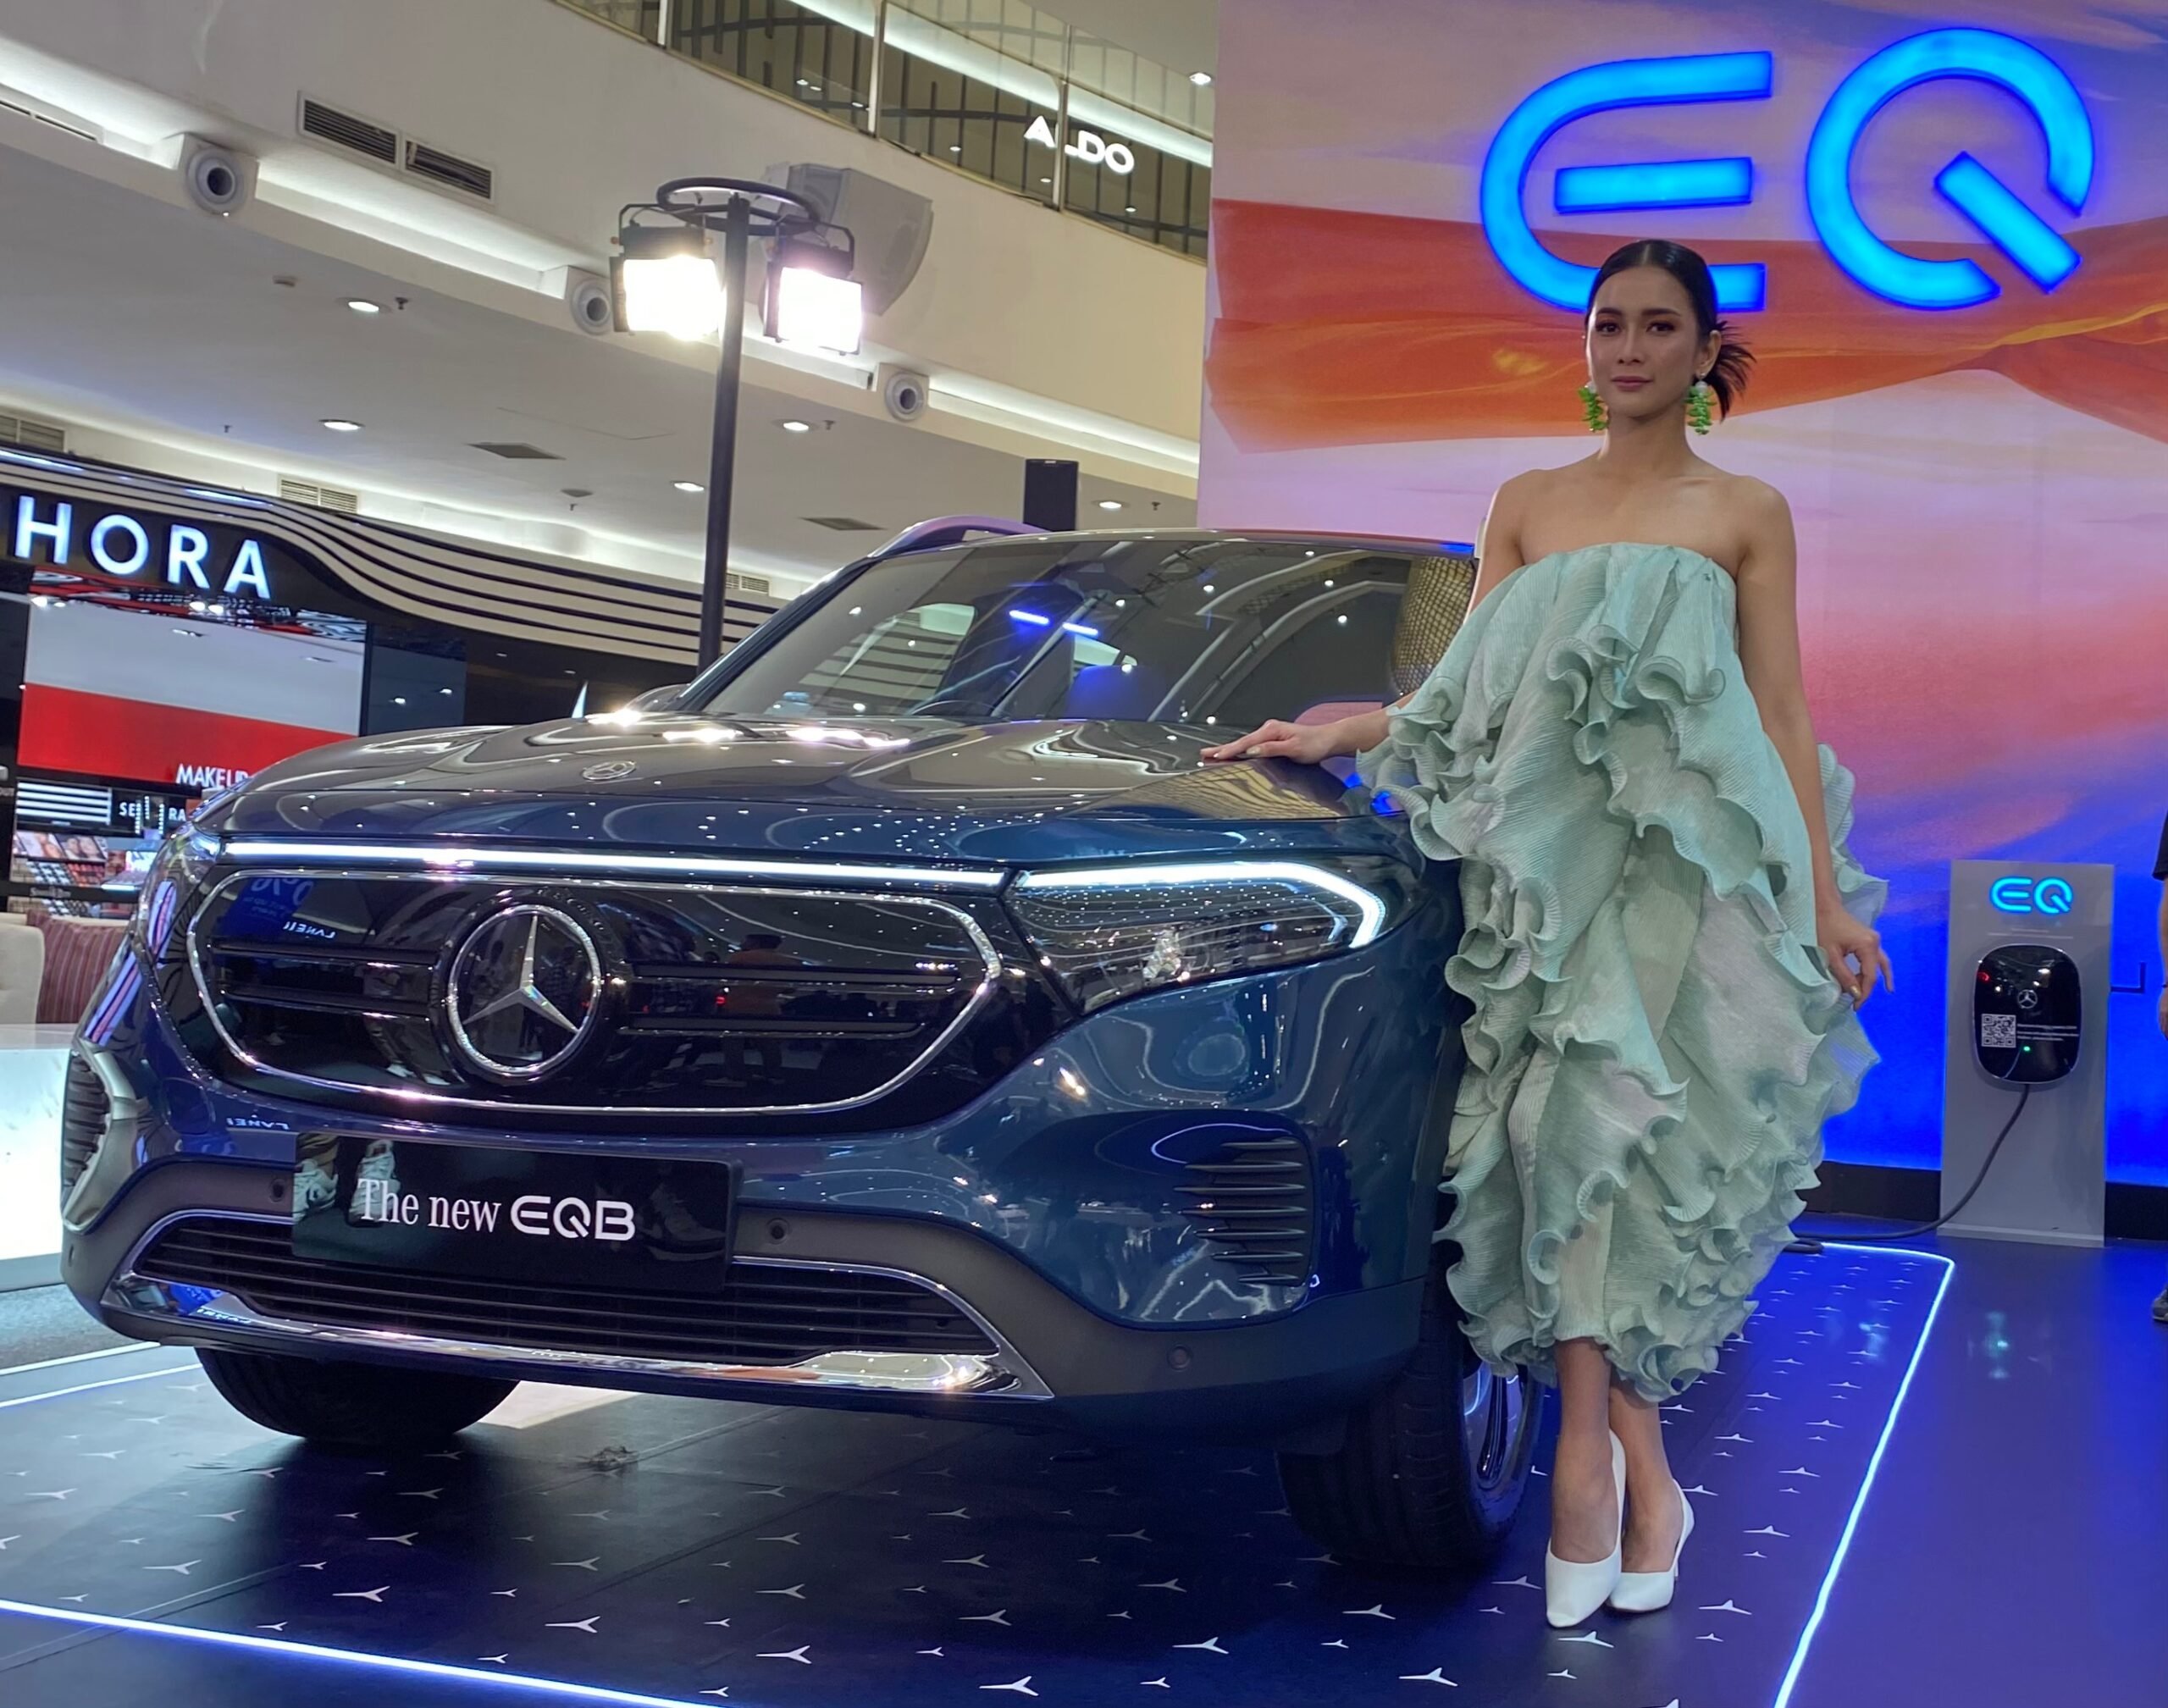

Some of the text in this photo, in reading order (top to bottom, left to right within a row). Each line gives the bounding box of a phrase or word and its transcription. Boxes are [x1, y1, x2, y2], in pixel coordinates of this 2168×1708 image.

[1479, 26, 2094, 312] EQ
[14, 495, 271, 599] HORA
[119, 801, 186, 821] SERA
[1991, 876, 2073, 914] EQ
[357, 1178, 635, 1241] The new EQB
